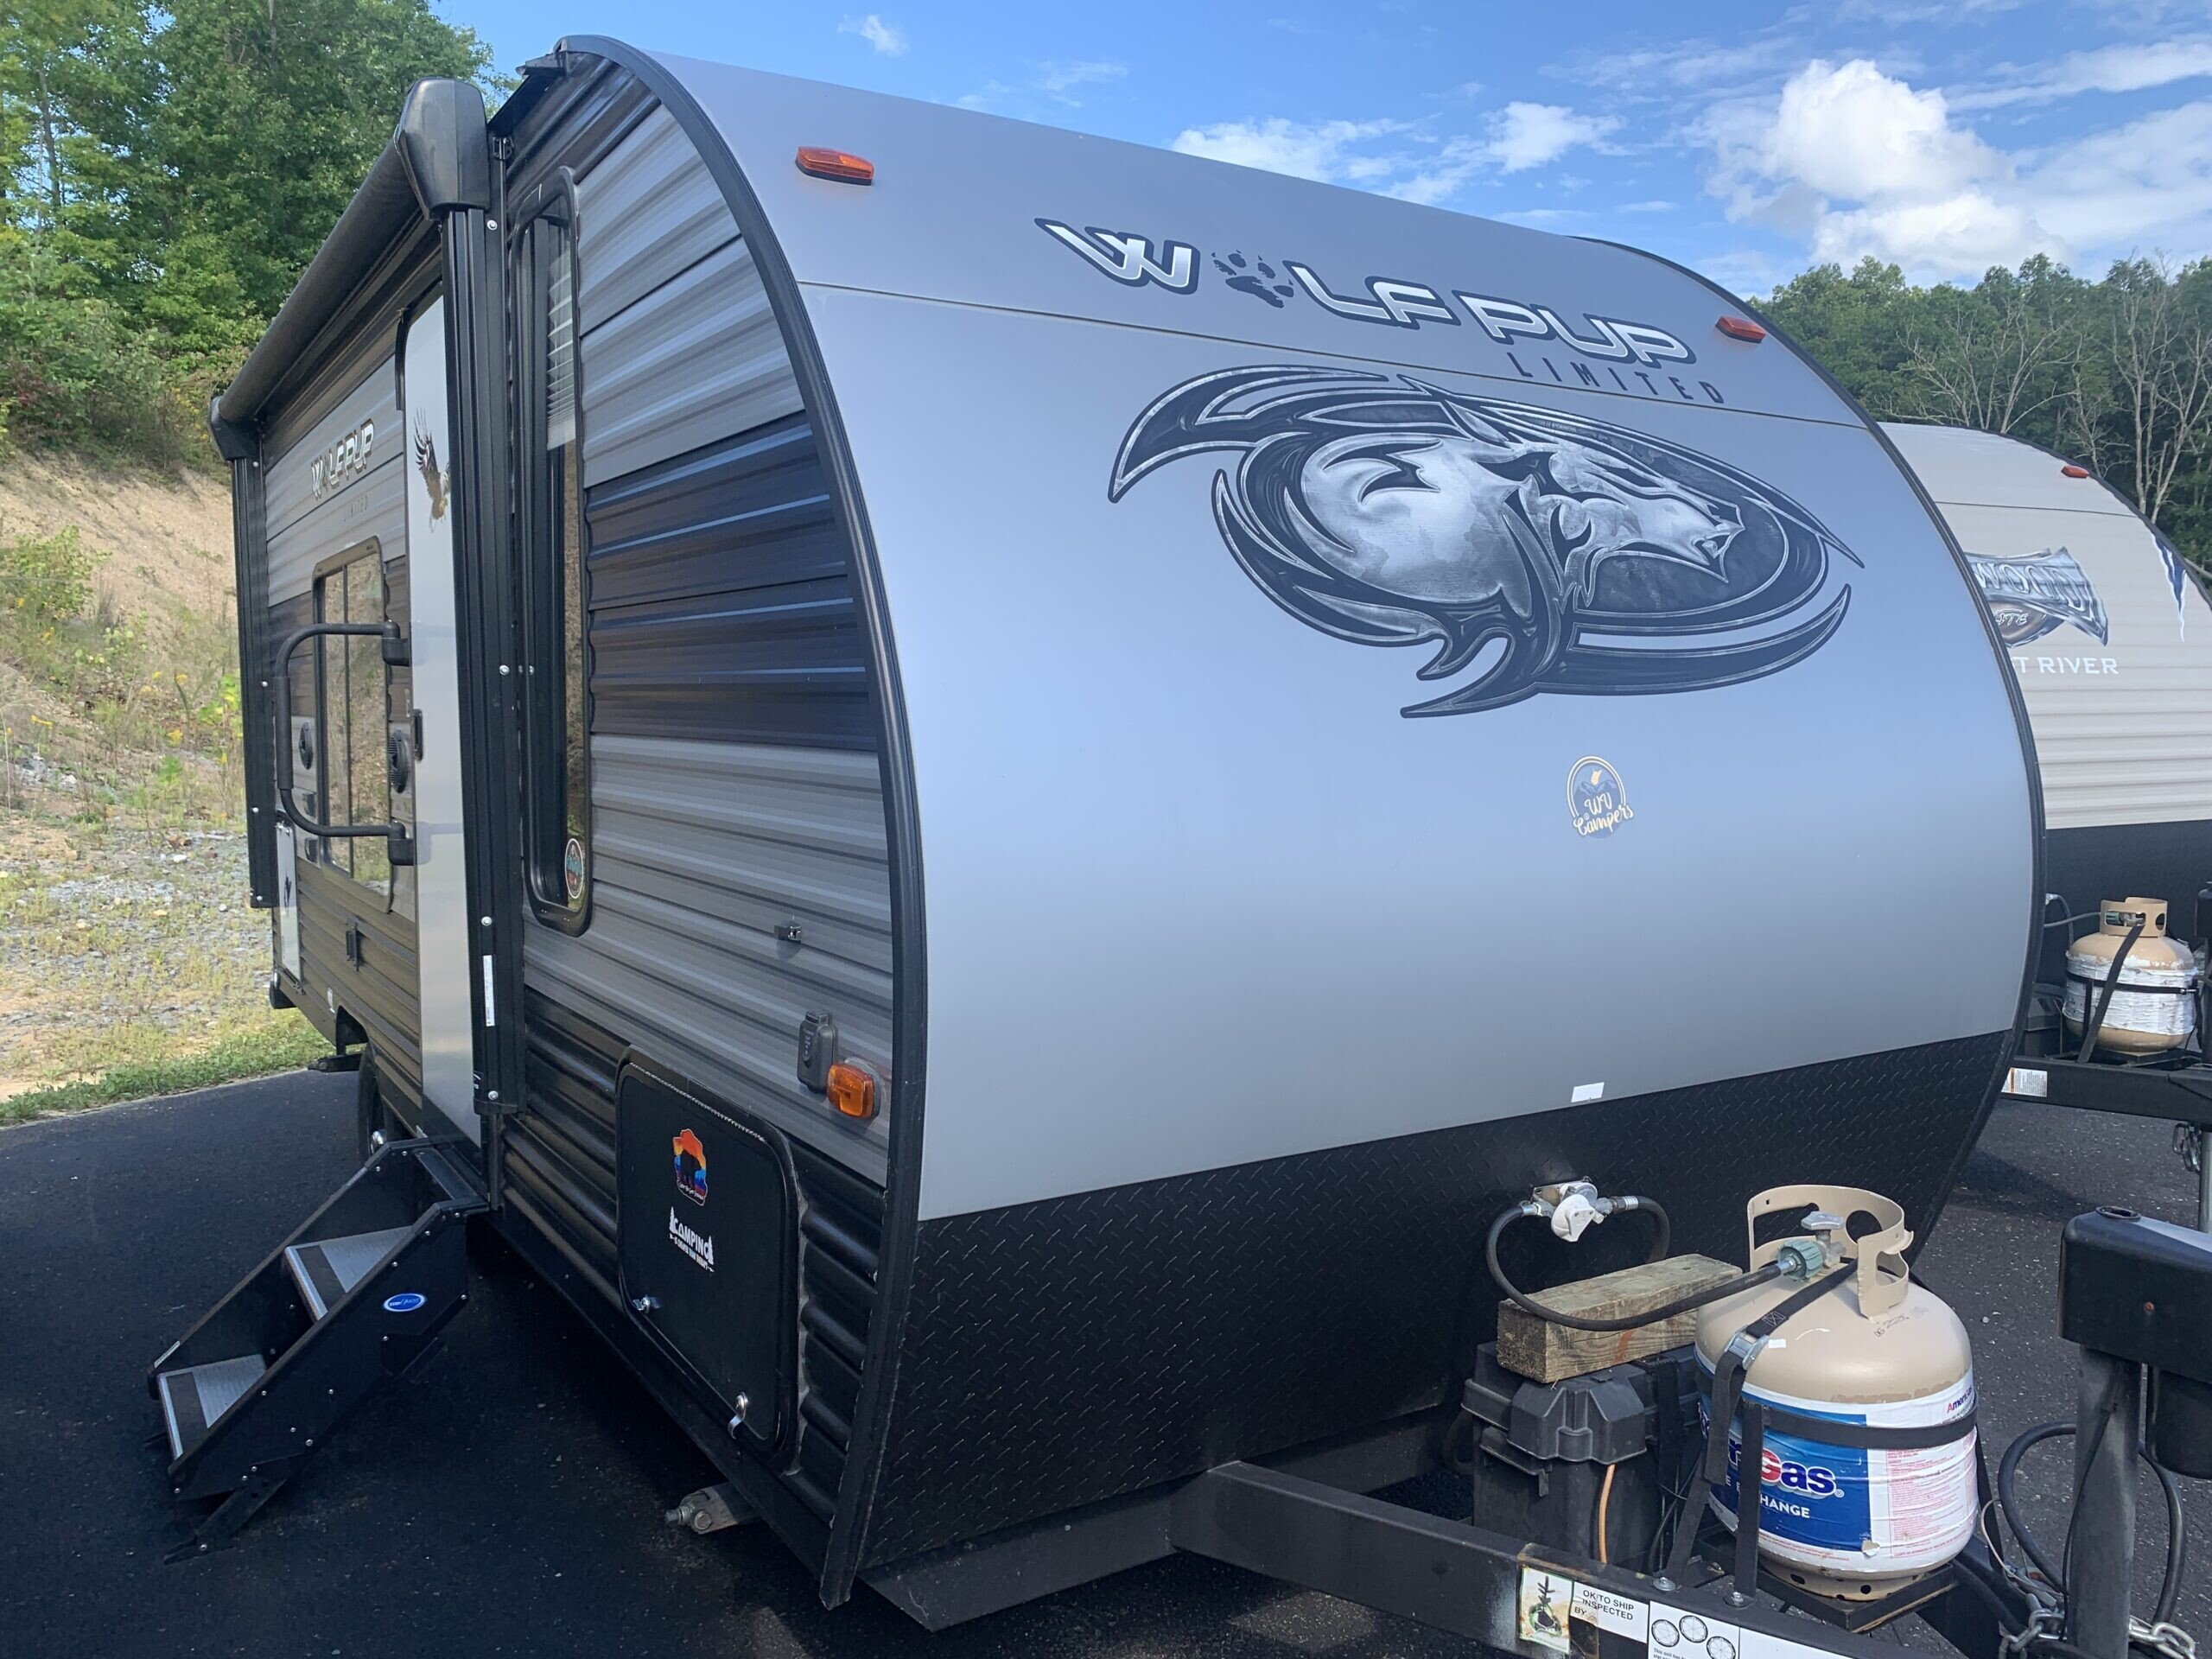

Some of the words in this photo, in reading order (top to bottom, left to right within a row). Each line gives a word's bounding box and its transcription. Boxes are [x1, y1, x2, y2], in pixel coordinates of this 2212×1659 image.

[1507, 352, 1724, 404] LIMITED
[2037, 656, 2119, 674] RIVER
[1573, 804, 1634, 836] Campers
[1574, 1605, 1587, 1616] BY
[1582, 1598, 1633, 1621] INSPECTED
[1583, 1589, 1596, 1600] OK
[1597, 1594, 1611, 1605] TO
[1613, 1599, 1634, 1611] SHIP
